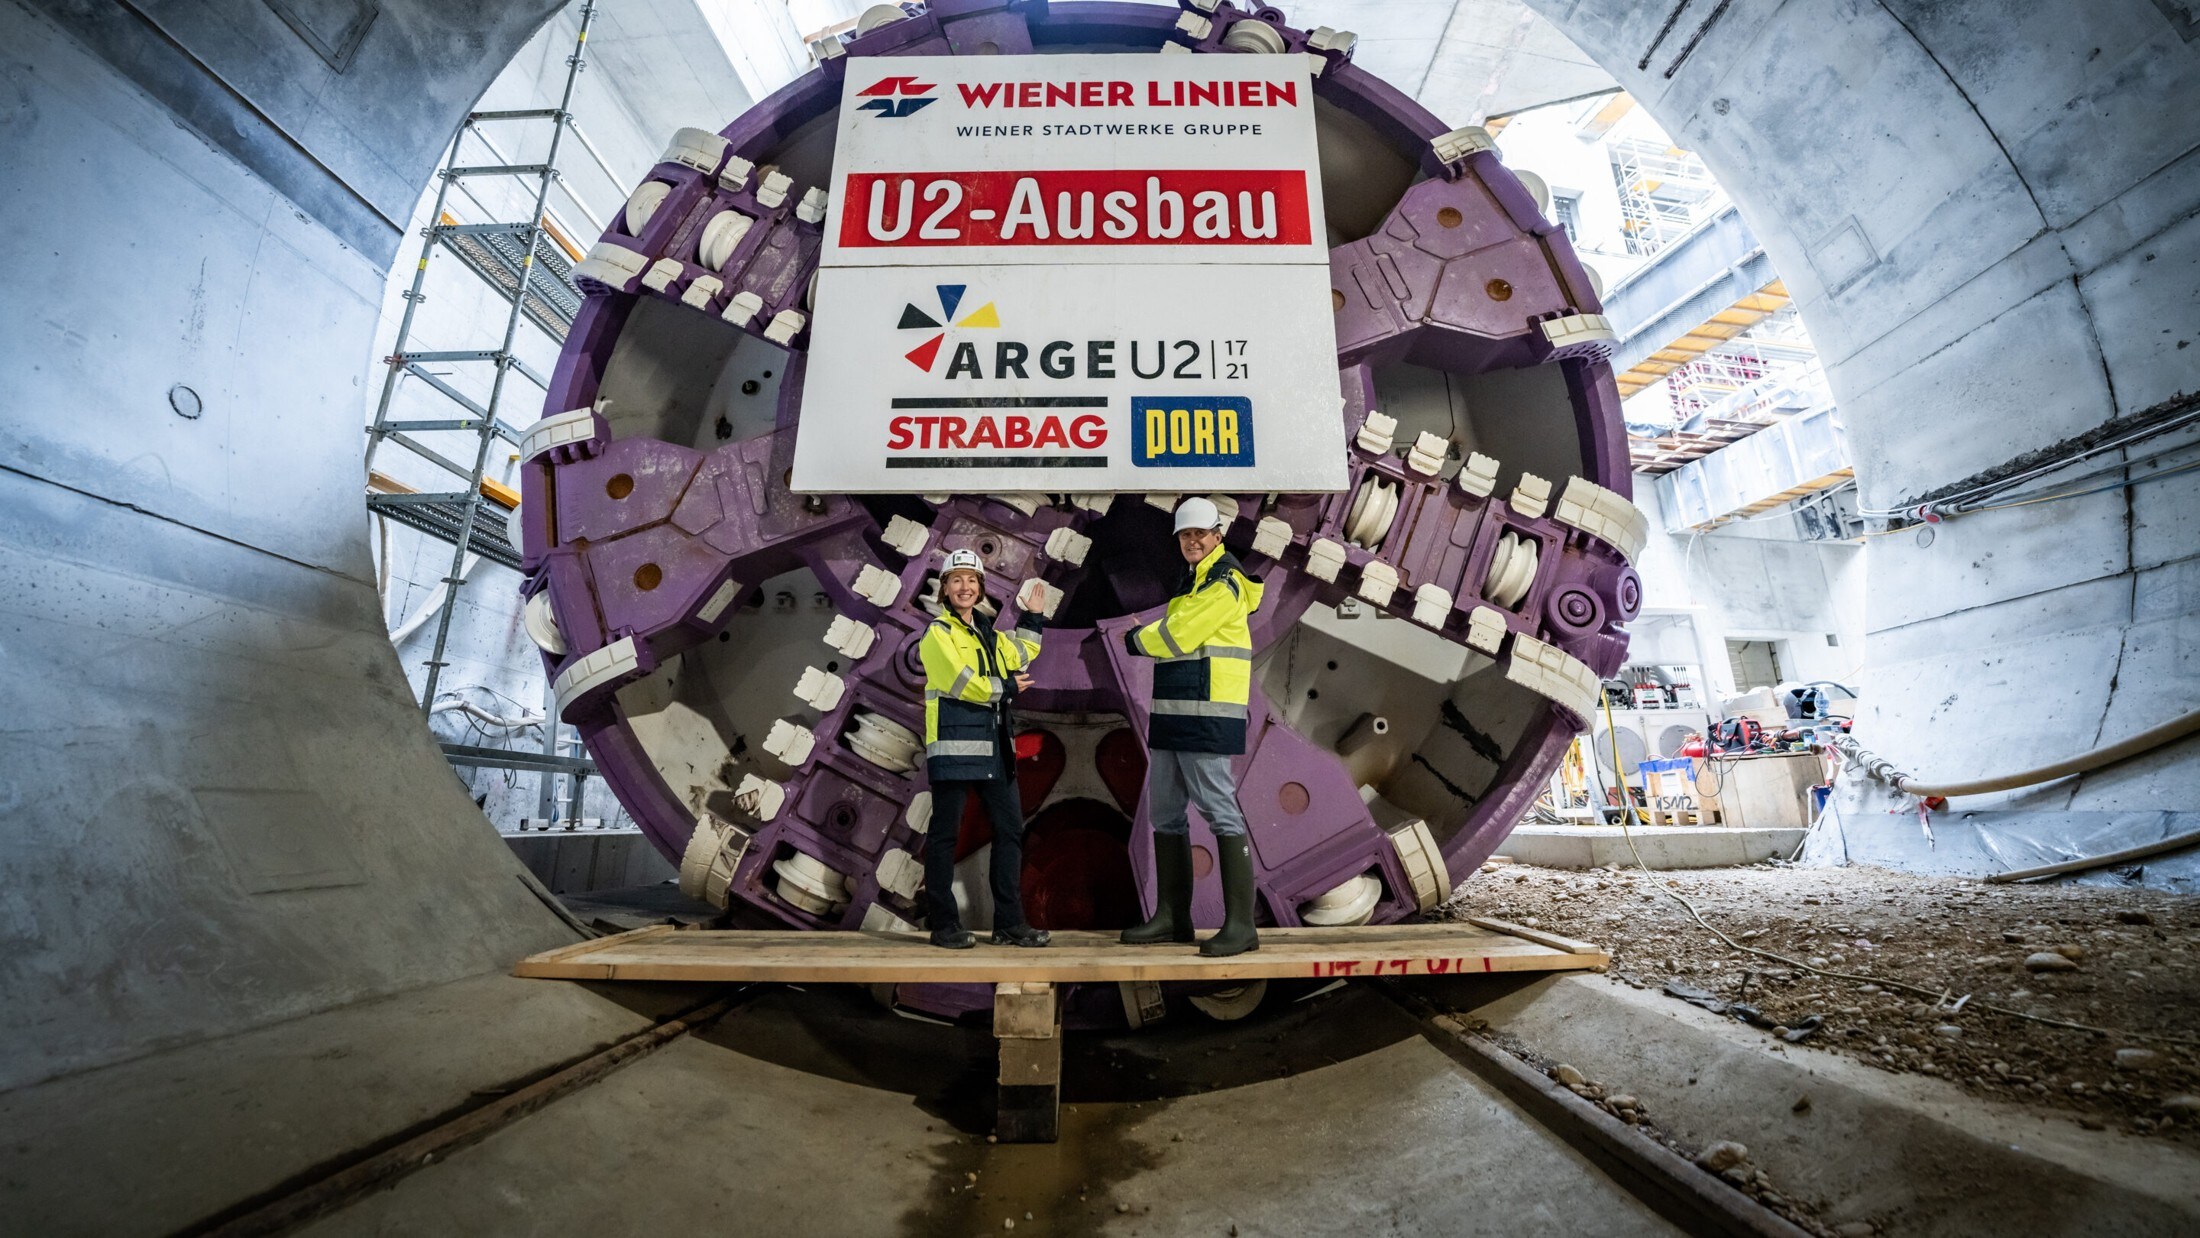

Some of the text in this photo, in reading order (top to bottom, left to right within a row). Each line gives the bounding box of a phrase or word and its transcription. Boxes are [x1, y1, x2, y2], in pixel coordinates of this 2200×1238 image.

[956, 80, 1298, 109] WIENER LINIEN
[956, 123, 1263, 137] WIENER STADTWERKE GRUPPE
[866, 176, 1278, 241] U2-Ausbau
[945, 339, 1202, 380] ARGE U2
[1224, 340, 1248, 356] 17
[1226, 362, 1249, 380] 21
[885, 409, 1239, 459] STRABAG PORR
